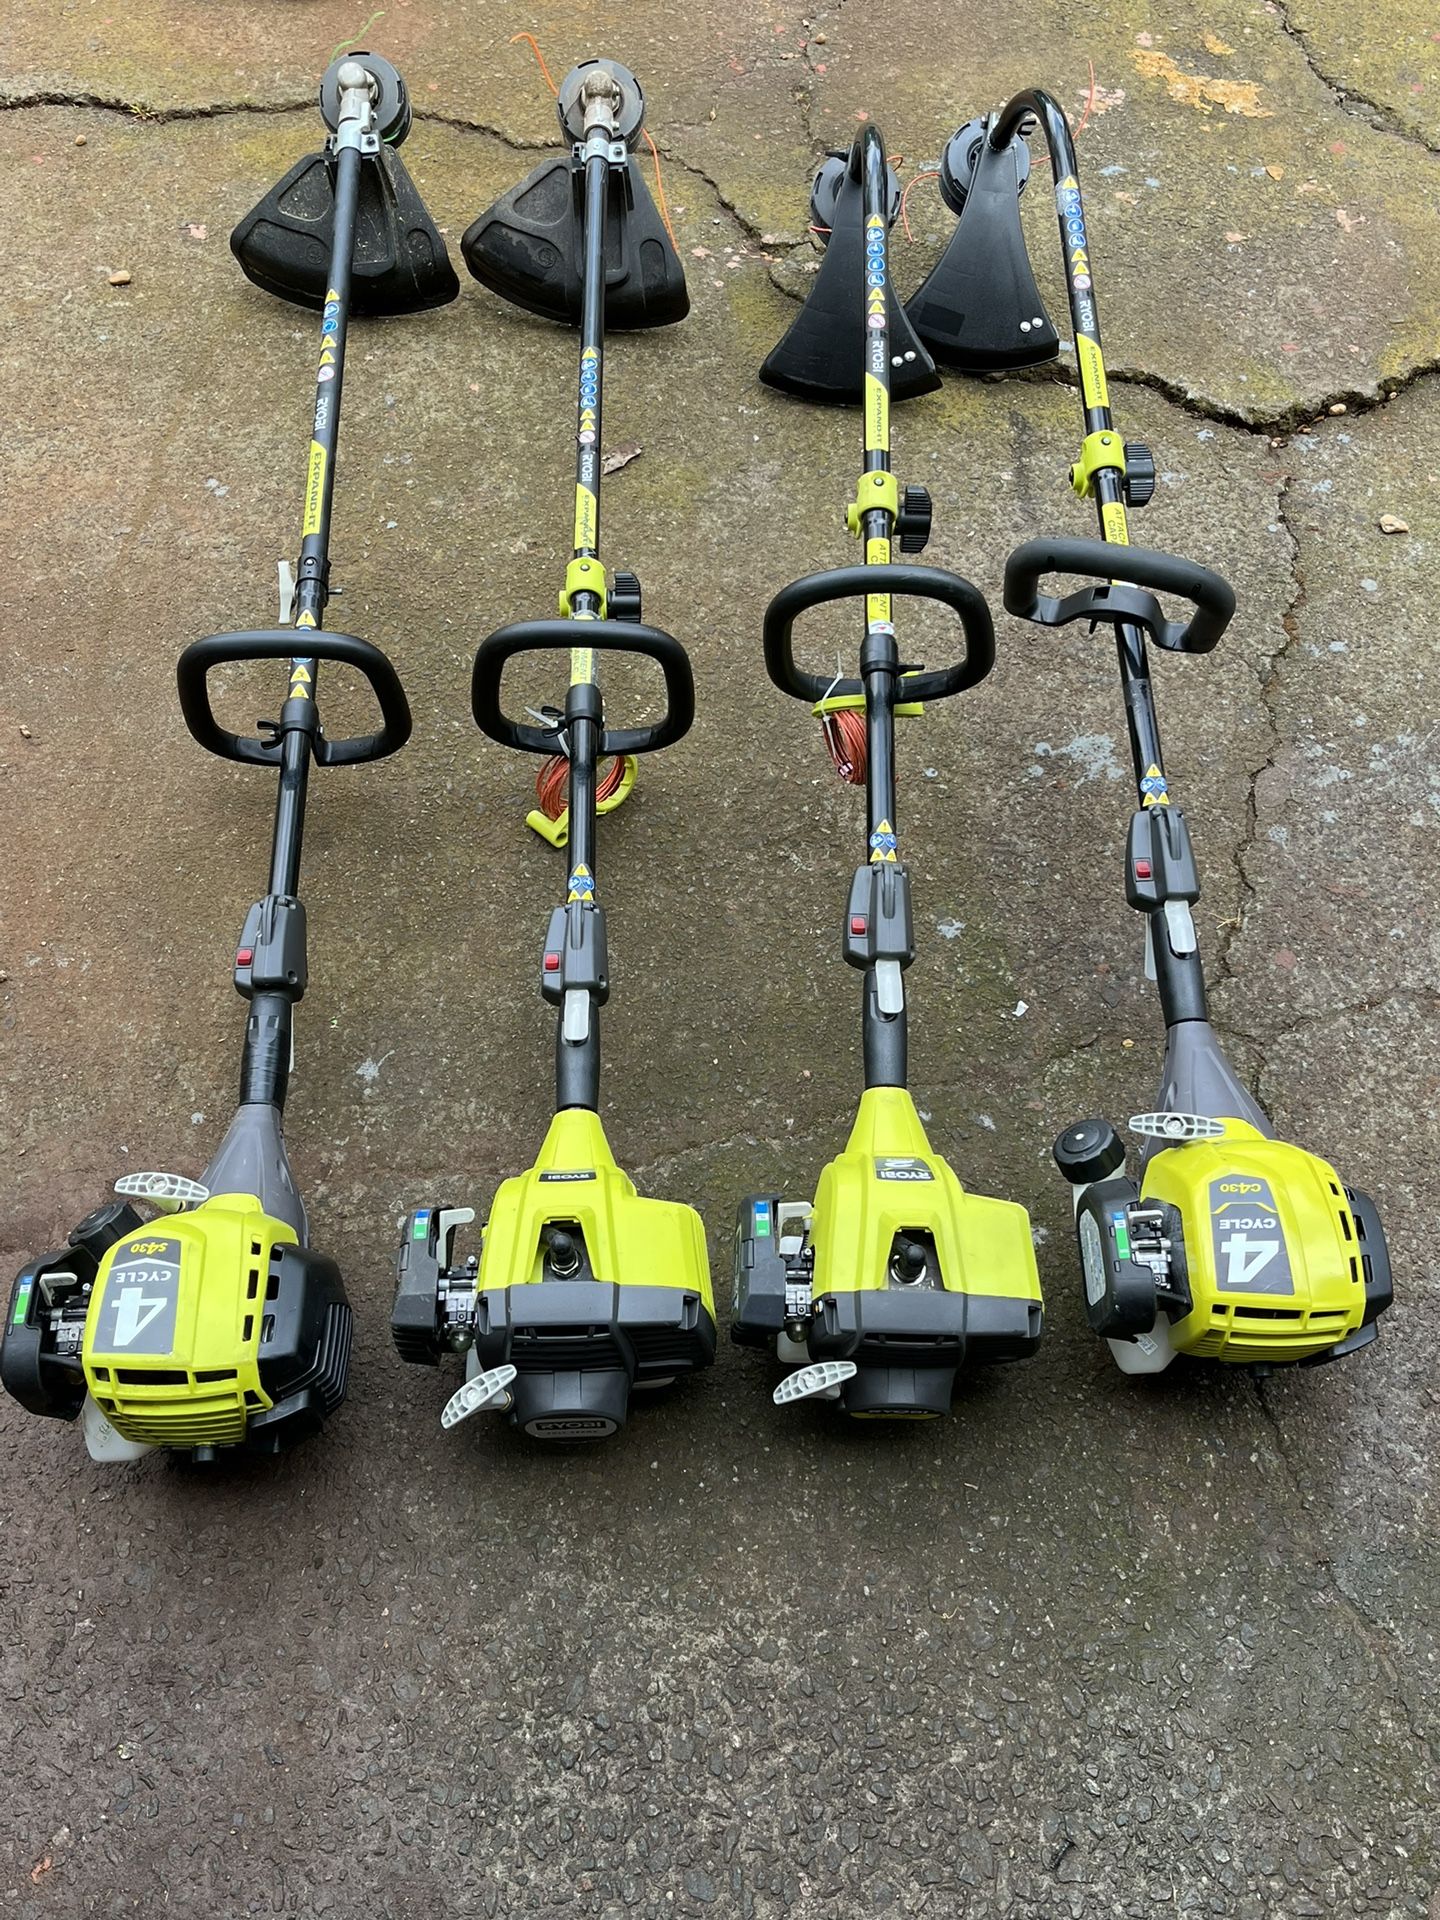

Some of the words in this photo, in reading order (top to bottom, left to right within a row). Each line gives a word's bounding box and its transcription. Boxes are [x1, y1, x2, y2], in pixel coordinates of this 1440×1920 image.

[1079, 299, 1095, 332] RYOBI
[872, 340, 884, 373] RYOBI
[314, 396, 328, 431] RYOBI
[581, 453, 593, 482] RYOBI
[880, 1171, 931, 1179] RYOBI
[1219, 1183, 1262, 1194] C430
[1218, 1218, 1277, 1229] CYCLE
[130, 1242, 168, 1255] S430
[1221, 1233, 1280, 1283] 4
[115, 1270, 172, 1283] CYCLE
[111, 1287, 168, 1347] 4
